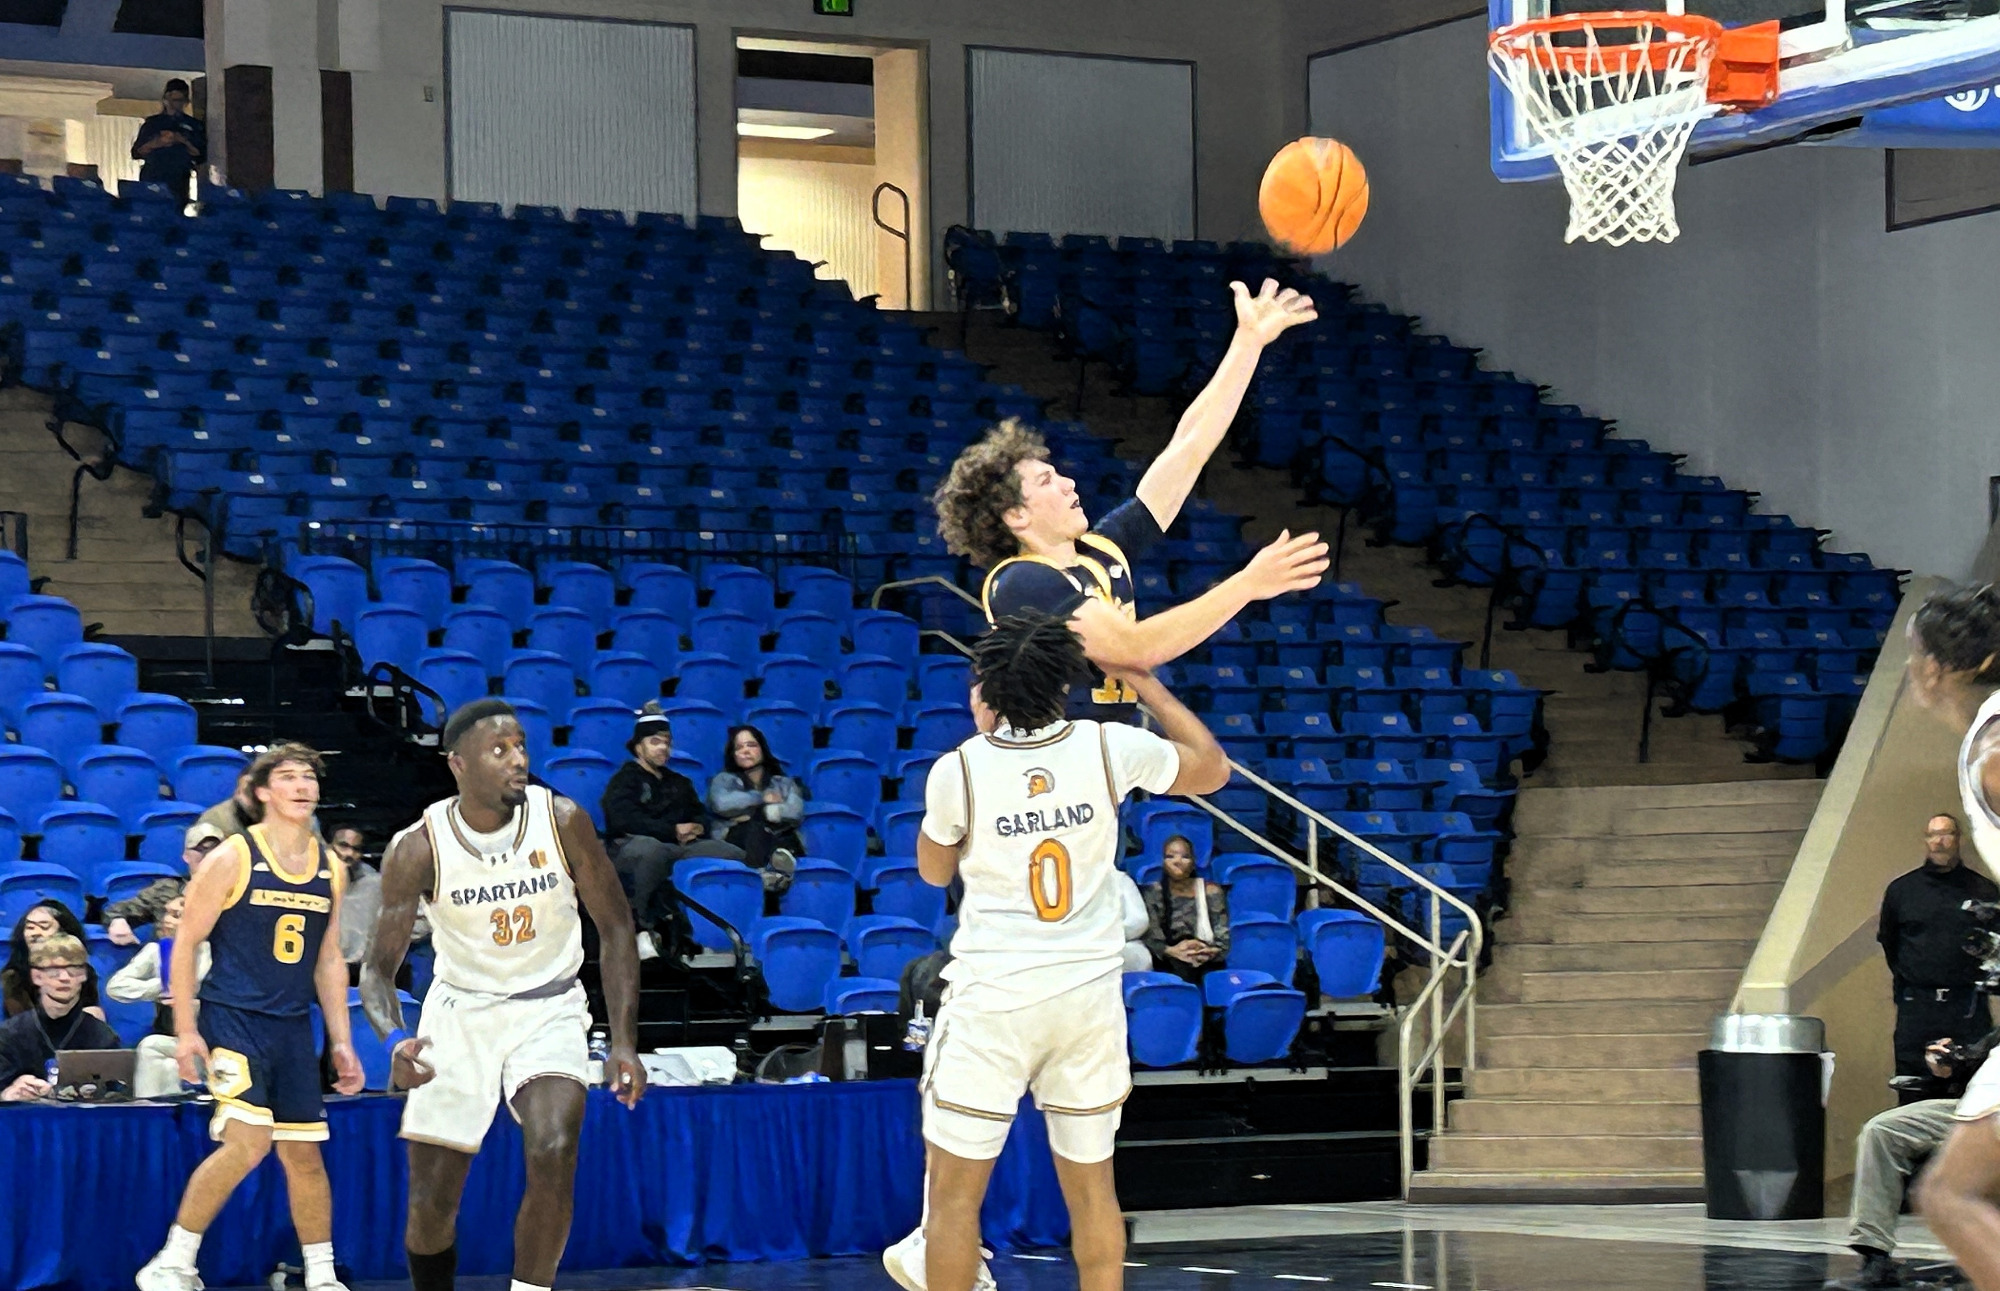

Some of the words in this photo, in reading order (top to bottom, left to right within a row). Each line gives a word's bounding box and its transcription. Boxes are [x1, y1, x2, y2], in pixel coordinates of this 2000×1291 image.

[996, 803, 1094, 837] GARLAND
[450, 872, 559, 906] SPARTANS
[1028, 838, 1073, 922] 0
[273, 914, 306, 964] 6
[490, 905, 536, 946] 32
